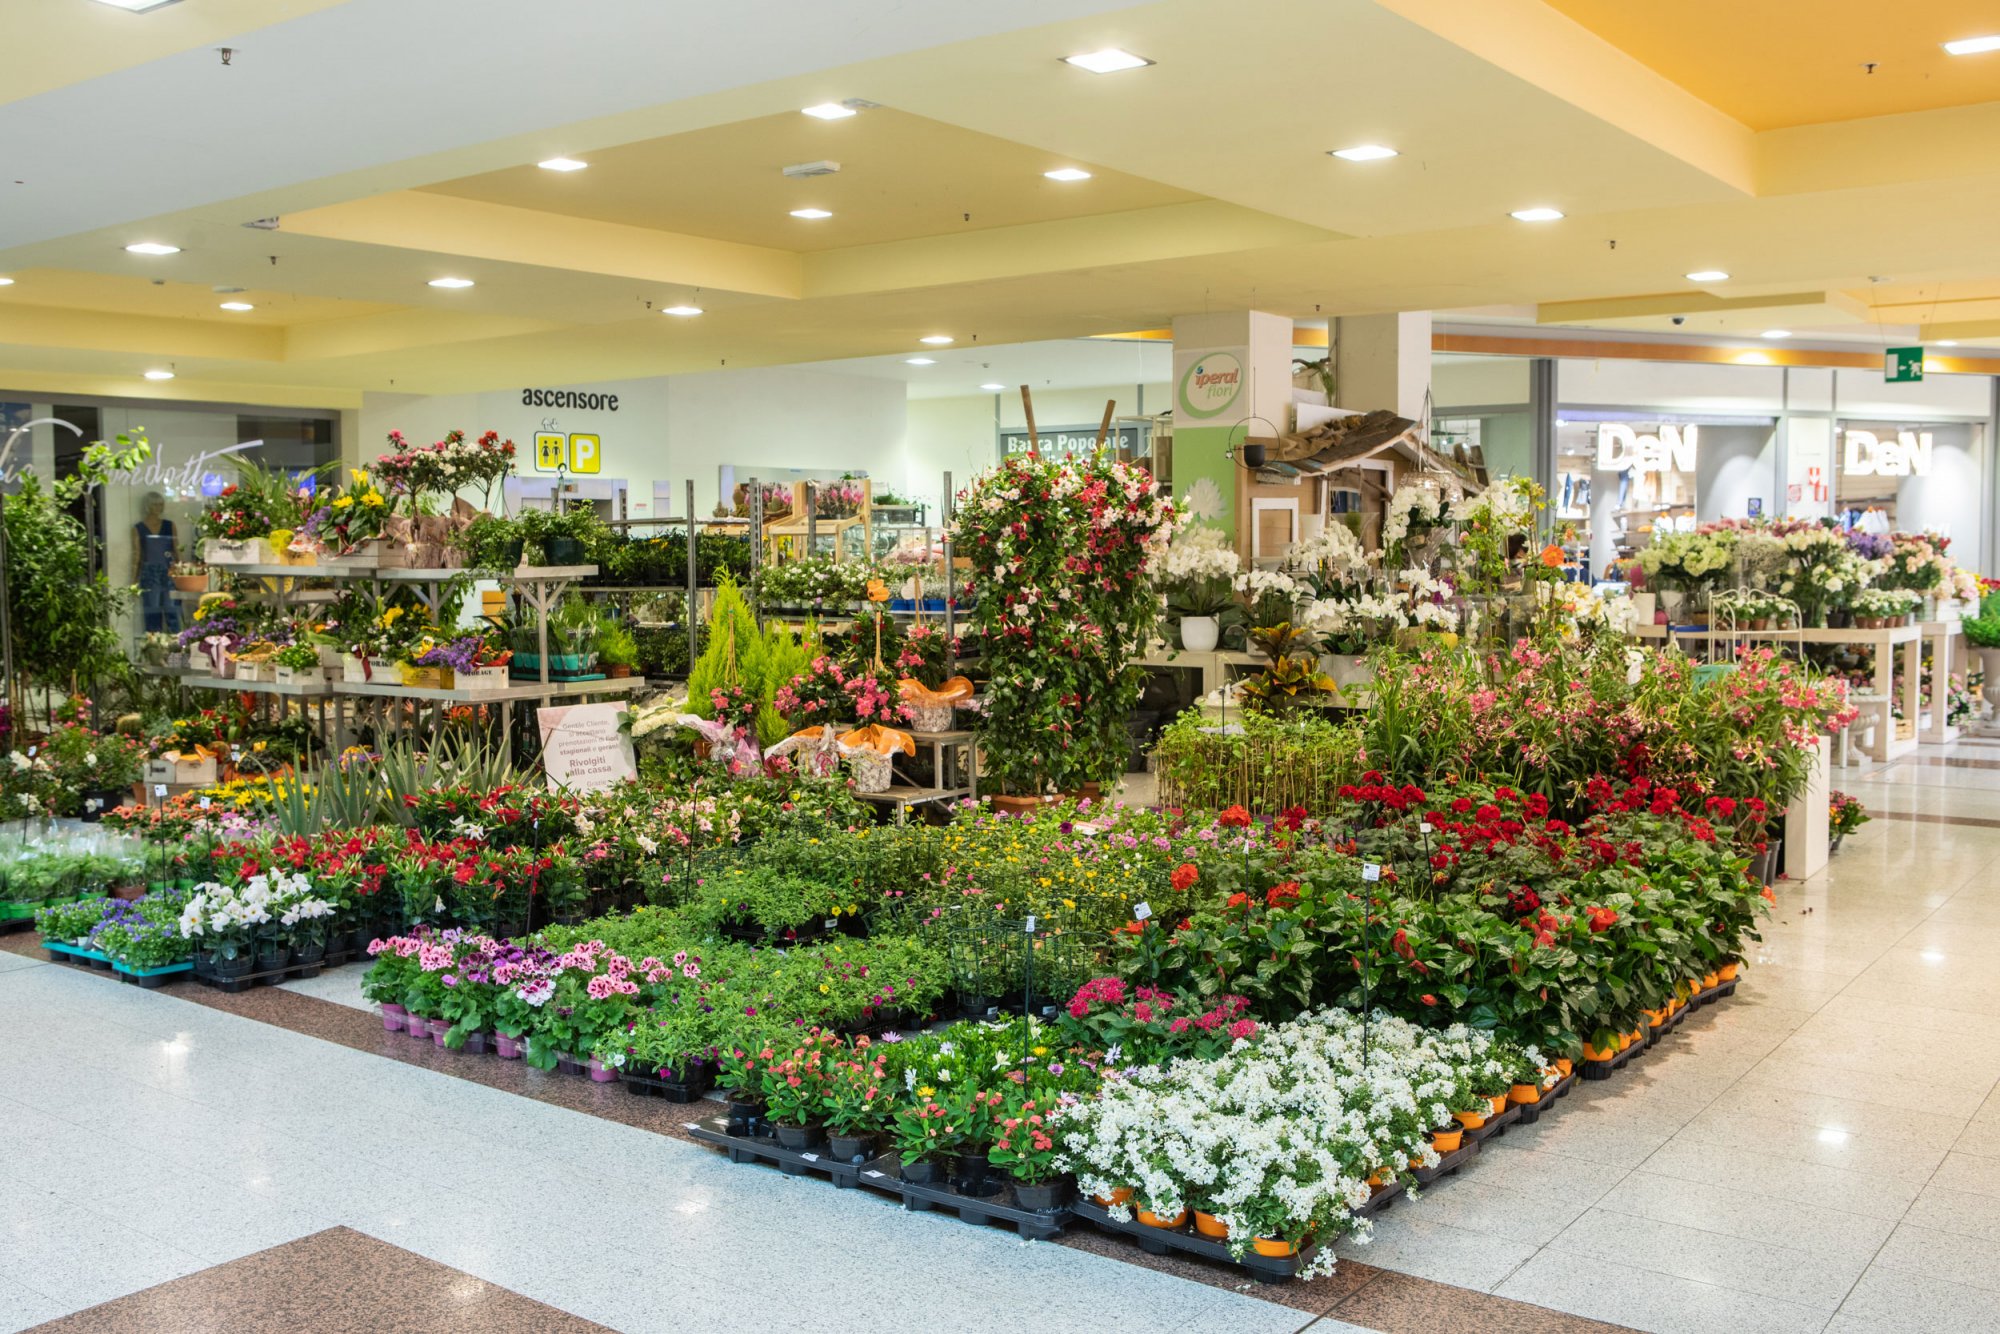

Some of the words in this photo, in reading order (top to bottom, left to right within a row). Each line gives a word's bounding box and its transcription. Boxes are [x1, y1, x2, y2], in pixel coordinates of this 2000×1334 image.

[1194, 366, 1239, 389] iperal
[522, 388, 619, 411] ascensore
[1207, 383, 1233, 400] fiori
[1057, 433, 1129, 453] Popoare
[575, 438, 595, 469] P
[569, 756, 606, 767] Rivolgiti
[570, 768, 585, 777] alla
[587, 765, 612, 774] cassa
